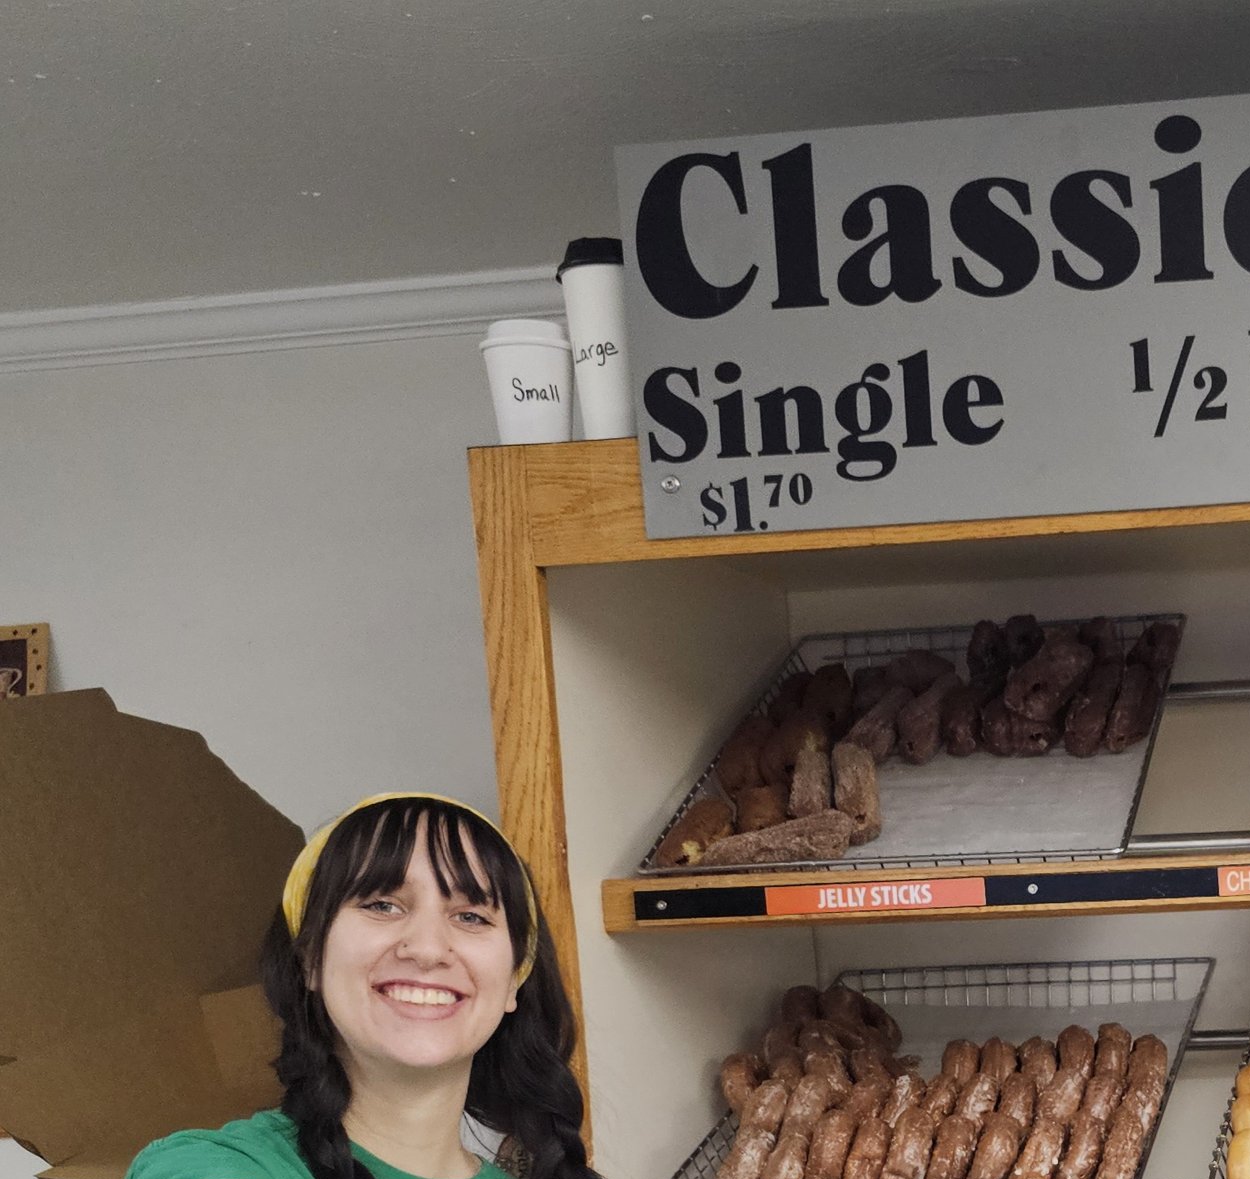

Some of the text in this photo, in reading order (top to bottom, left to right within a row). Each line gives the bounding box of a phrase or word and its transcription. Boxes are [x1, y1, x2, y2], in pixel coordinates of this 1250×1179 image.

[511, 377, 561, 404] Small
[643, 349, 1005, 482] Single
[699, 473, 814, 533] $1.70
[817, 883, 933, 909] JELLY STICKS
